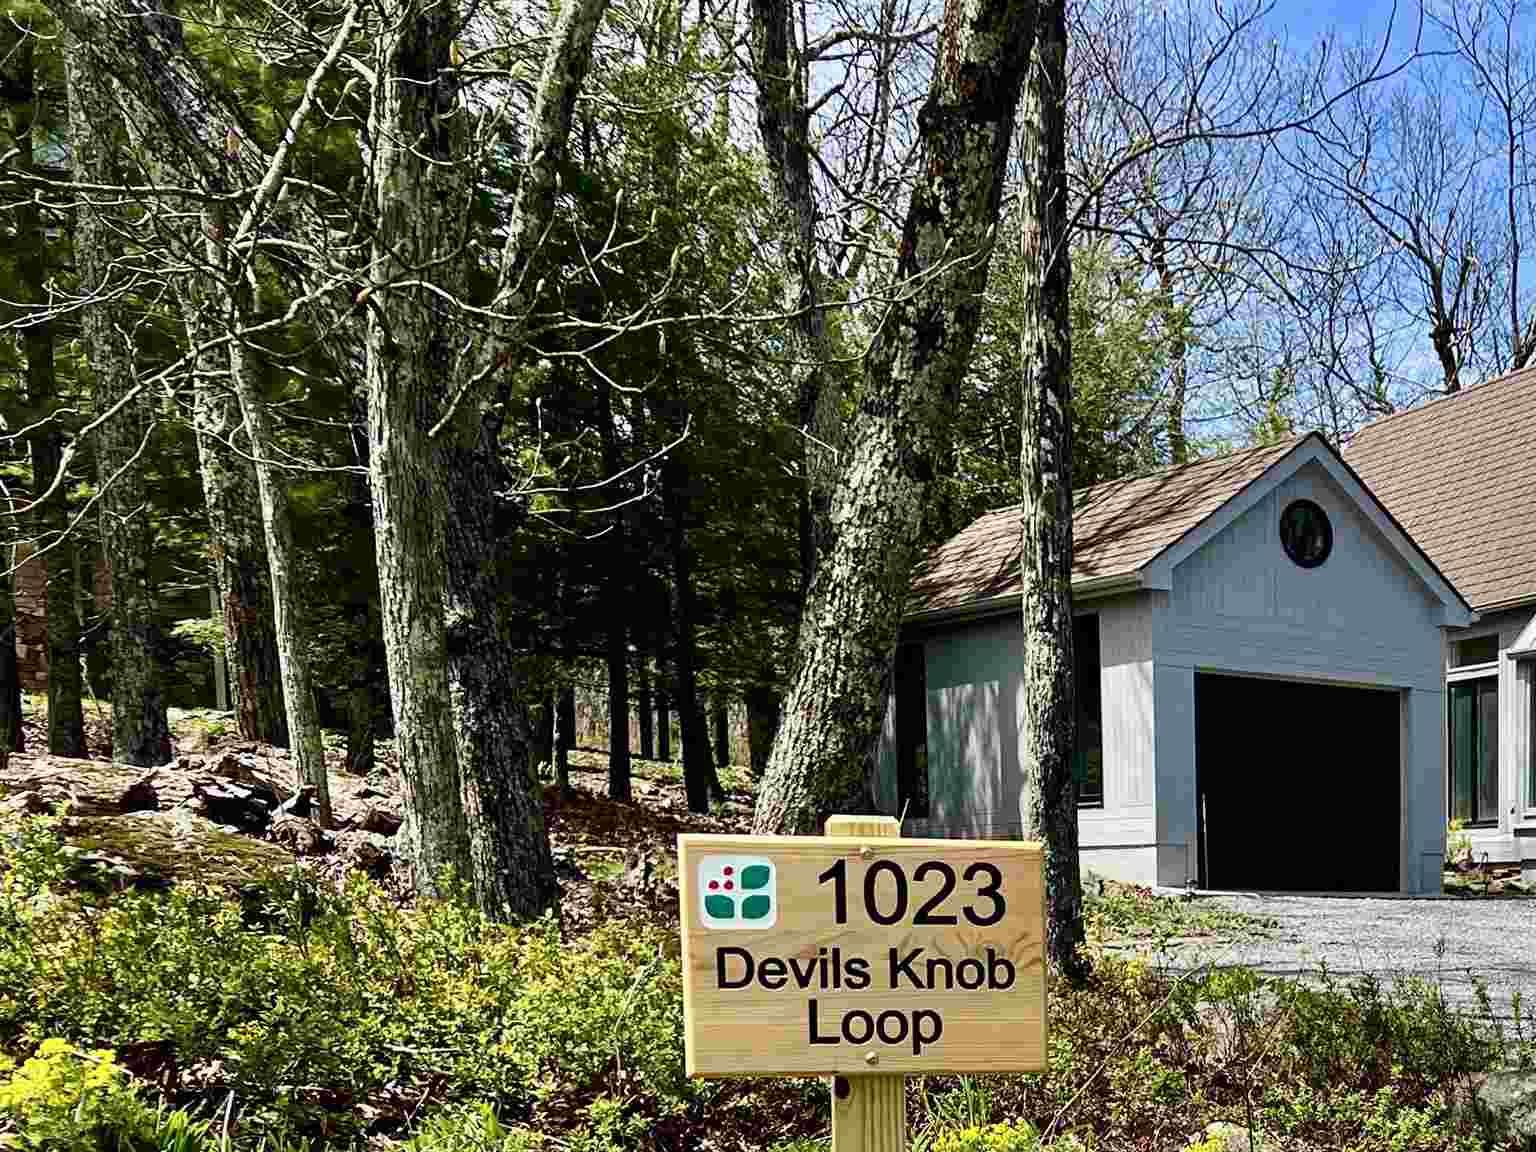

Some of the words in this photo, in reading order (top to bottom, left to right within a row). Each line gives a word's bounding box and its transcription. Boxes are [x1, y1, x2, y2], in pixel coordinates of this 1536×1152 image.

[817, 858, 1007, 927] 1023
[716, 946, 871, 990] Devils
[888, 947, 1016, 990] Knob
[808, 998, 943, 1056] Loop
